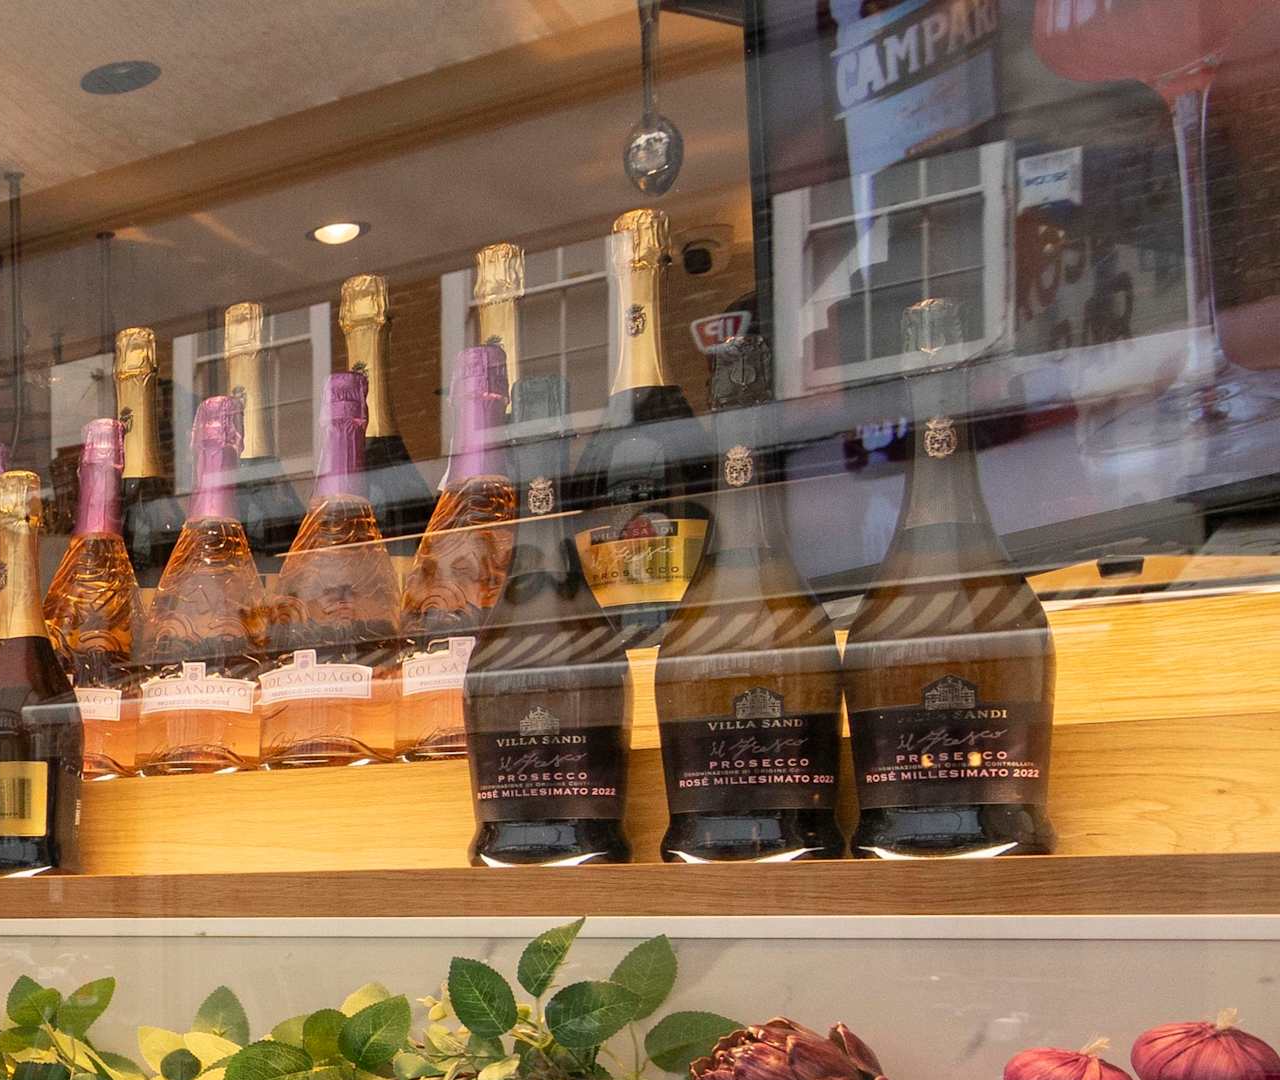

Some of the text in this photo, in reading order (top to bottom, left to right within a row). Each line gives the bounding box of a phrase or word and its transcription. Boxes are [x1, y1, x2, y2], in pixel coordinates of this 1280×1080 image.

[631, 526, 675, 537] SADI
[592, 565, 680, 582] PROSCCO
[285, 671, 364, 686] SANDAGO
[174, 684, 248, 699] SANDAGO
[708, 718, 803, 732] VILLA SAND
[496, 735, 587, 748] VILLA SANDI
[709, 758, 810, 770] PROSECCO
[497, 771, 589, 783] PROSECCO
[679, 774, 835, 788] ROSÉ MILLESIMATO 2022
[866, 768, 1040, 783] ROSÉ MILLESIMATO 2022
[477, 787, 617, 800] ROSÉ MILLESIMATO 2022
